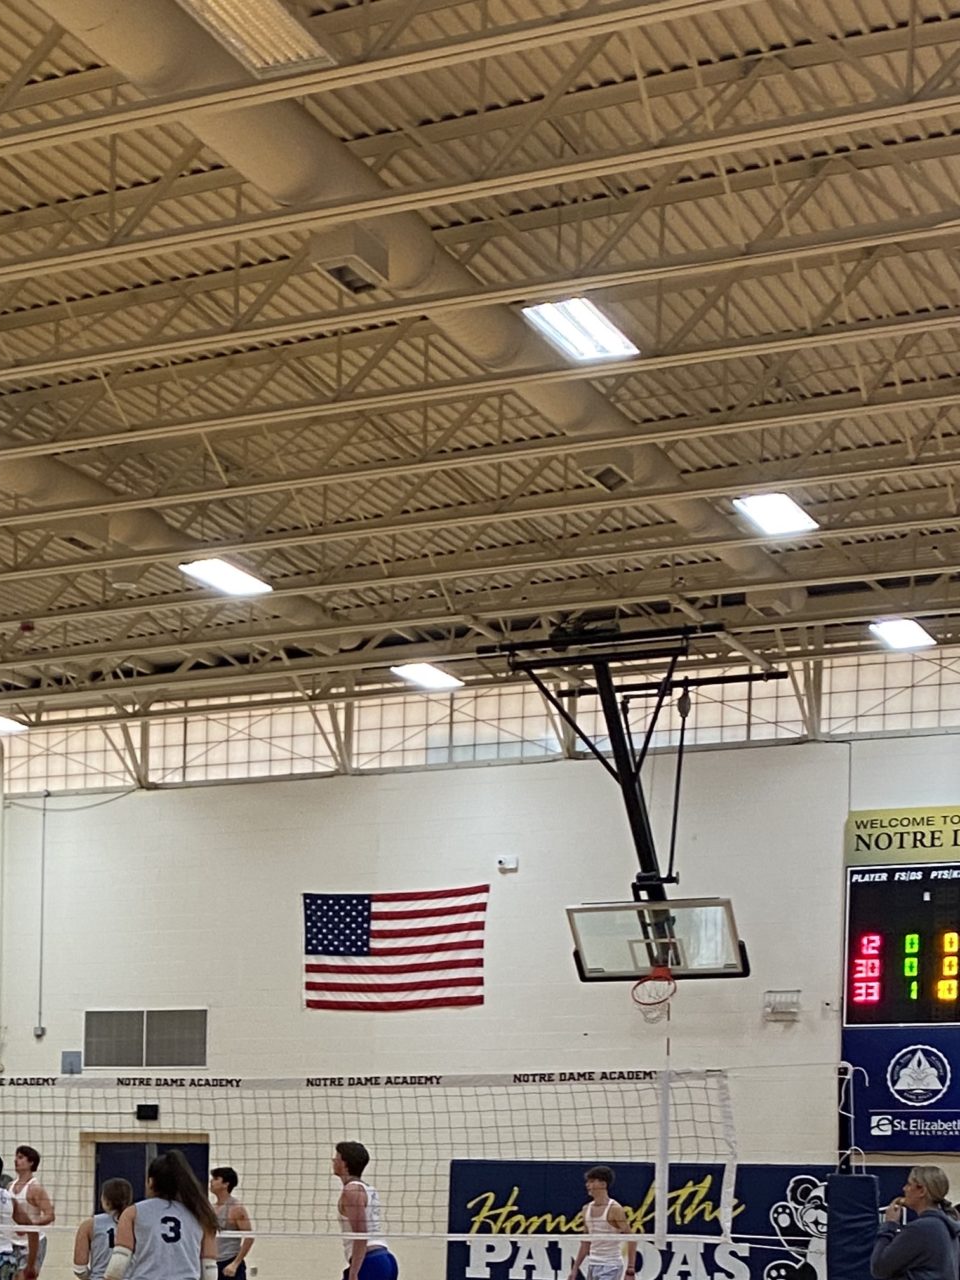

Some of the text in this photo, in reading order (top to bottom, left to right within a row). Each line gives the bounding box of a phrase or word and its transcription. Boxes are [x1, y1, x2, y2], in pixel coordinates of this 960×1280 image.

[855, 814, 960, 830] WELCOME TO
[854, 830, 943, 852] NOTRE
[852, 872, 888, 882] PLAYER
[862, 932, 958, 954] 12 0 0
[853, 956, 958, 978] 30 0 0
[853, 981, 880, 1001] 33
[910, 981, 918, 1000] 1
[8, 1077, 57, 1087] ACADEMY
[116, 1077, 241, 1088] NOTRE DAME ACADEMY
[306, 1075, 442, 1088] NOTRE DAME ACADEMY
[513, 1073, 555, 1083] NOTRE
[559, 1072, 595, 1082] DAME
[466, 1186, 586, 1235] Home
[665, 1175, 745, 1225] the
[160, 1216, 182, 1244] 3
